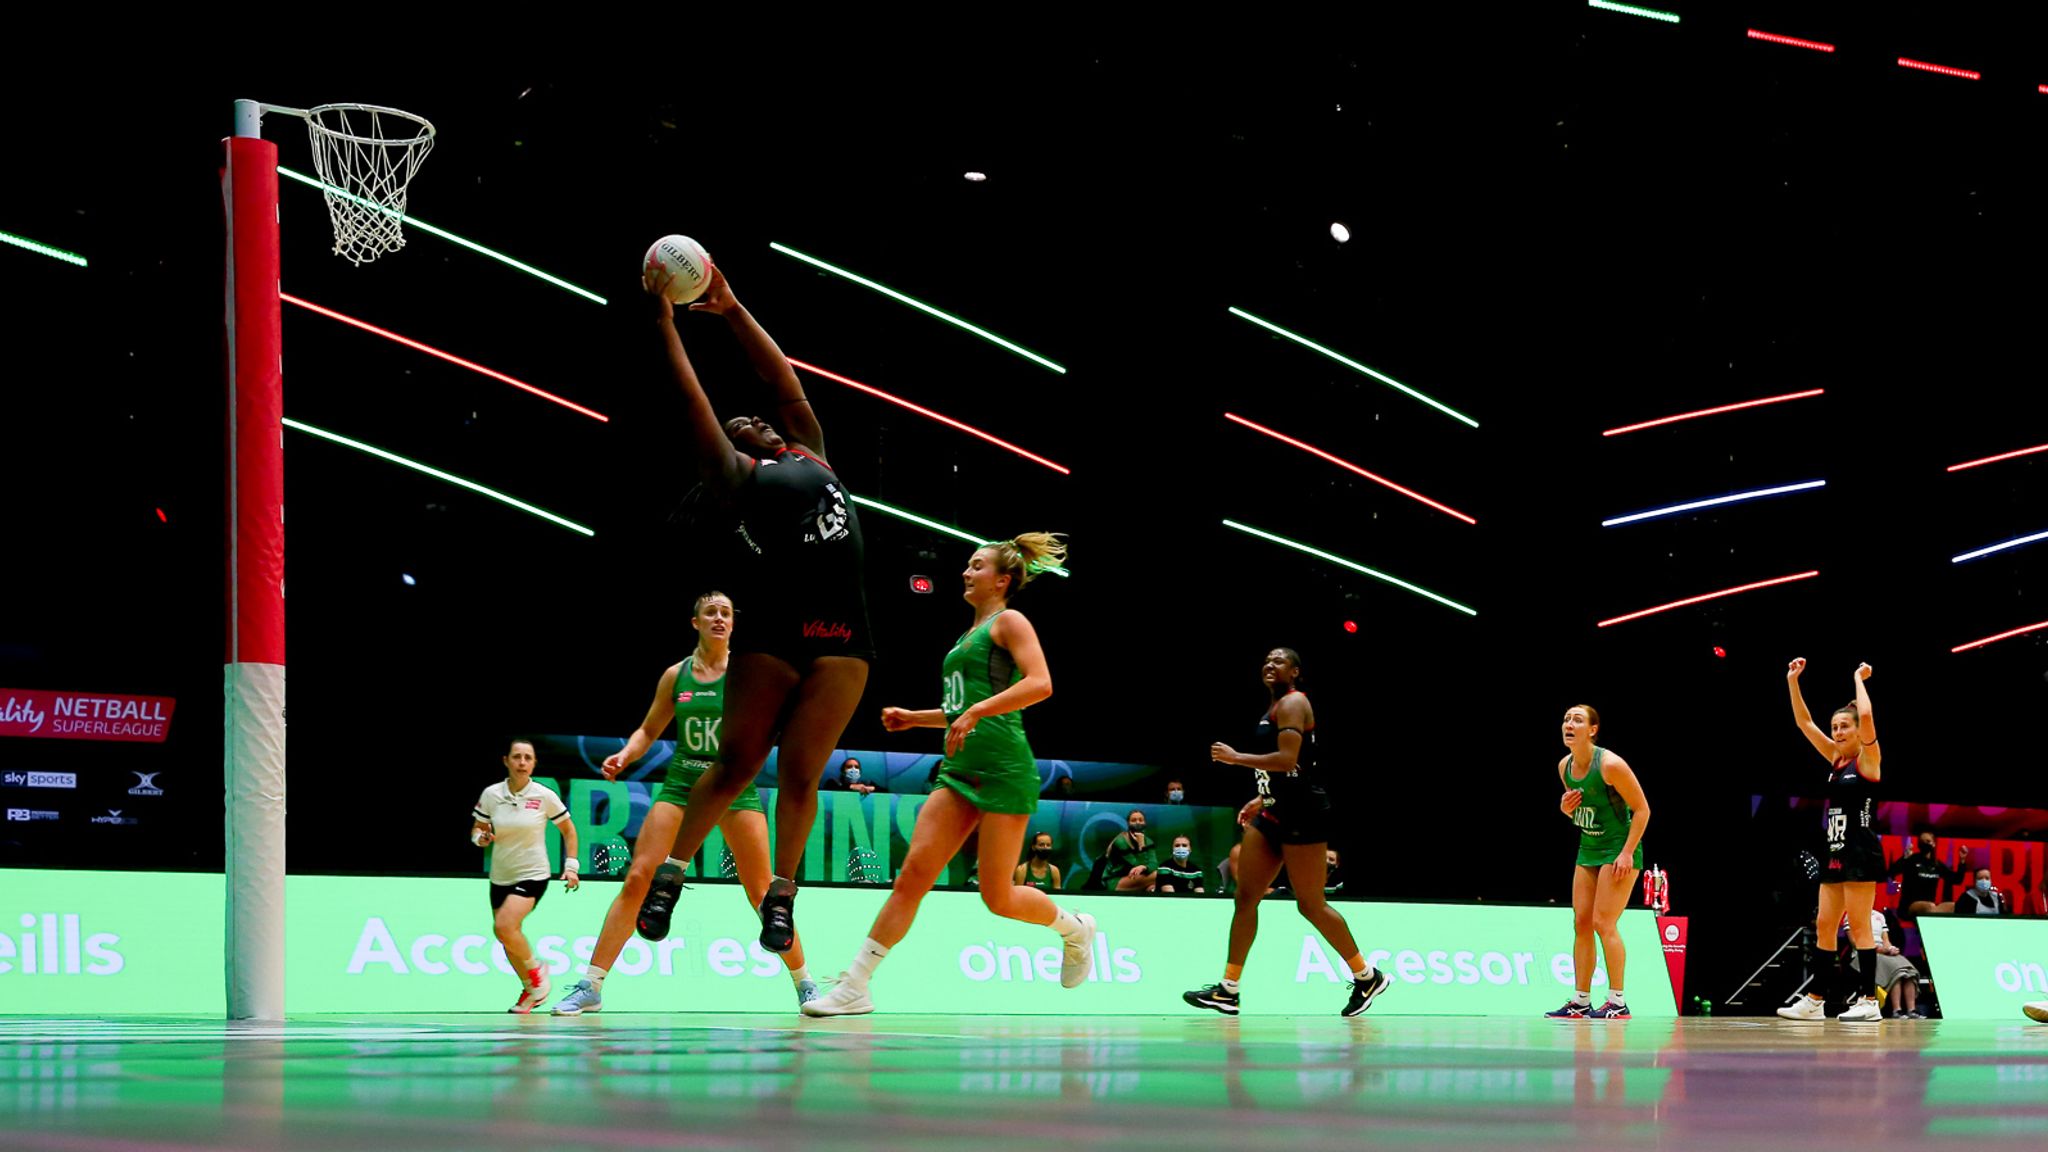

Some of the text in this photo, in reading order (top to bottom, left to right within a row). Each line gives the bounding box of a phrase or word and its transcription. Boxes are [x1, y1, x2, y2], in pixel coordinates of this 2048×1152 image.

[661, 243, 700, 281] GILBERT
[803, 620, 852, 644] Vitality
[53, 696, 168, 721] NETBALL
[52, 719, 164, 737] SUPERLEAGUE
[685, 716, 723, 752] GK
[4, 771, 74, 786] sky sports
